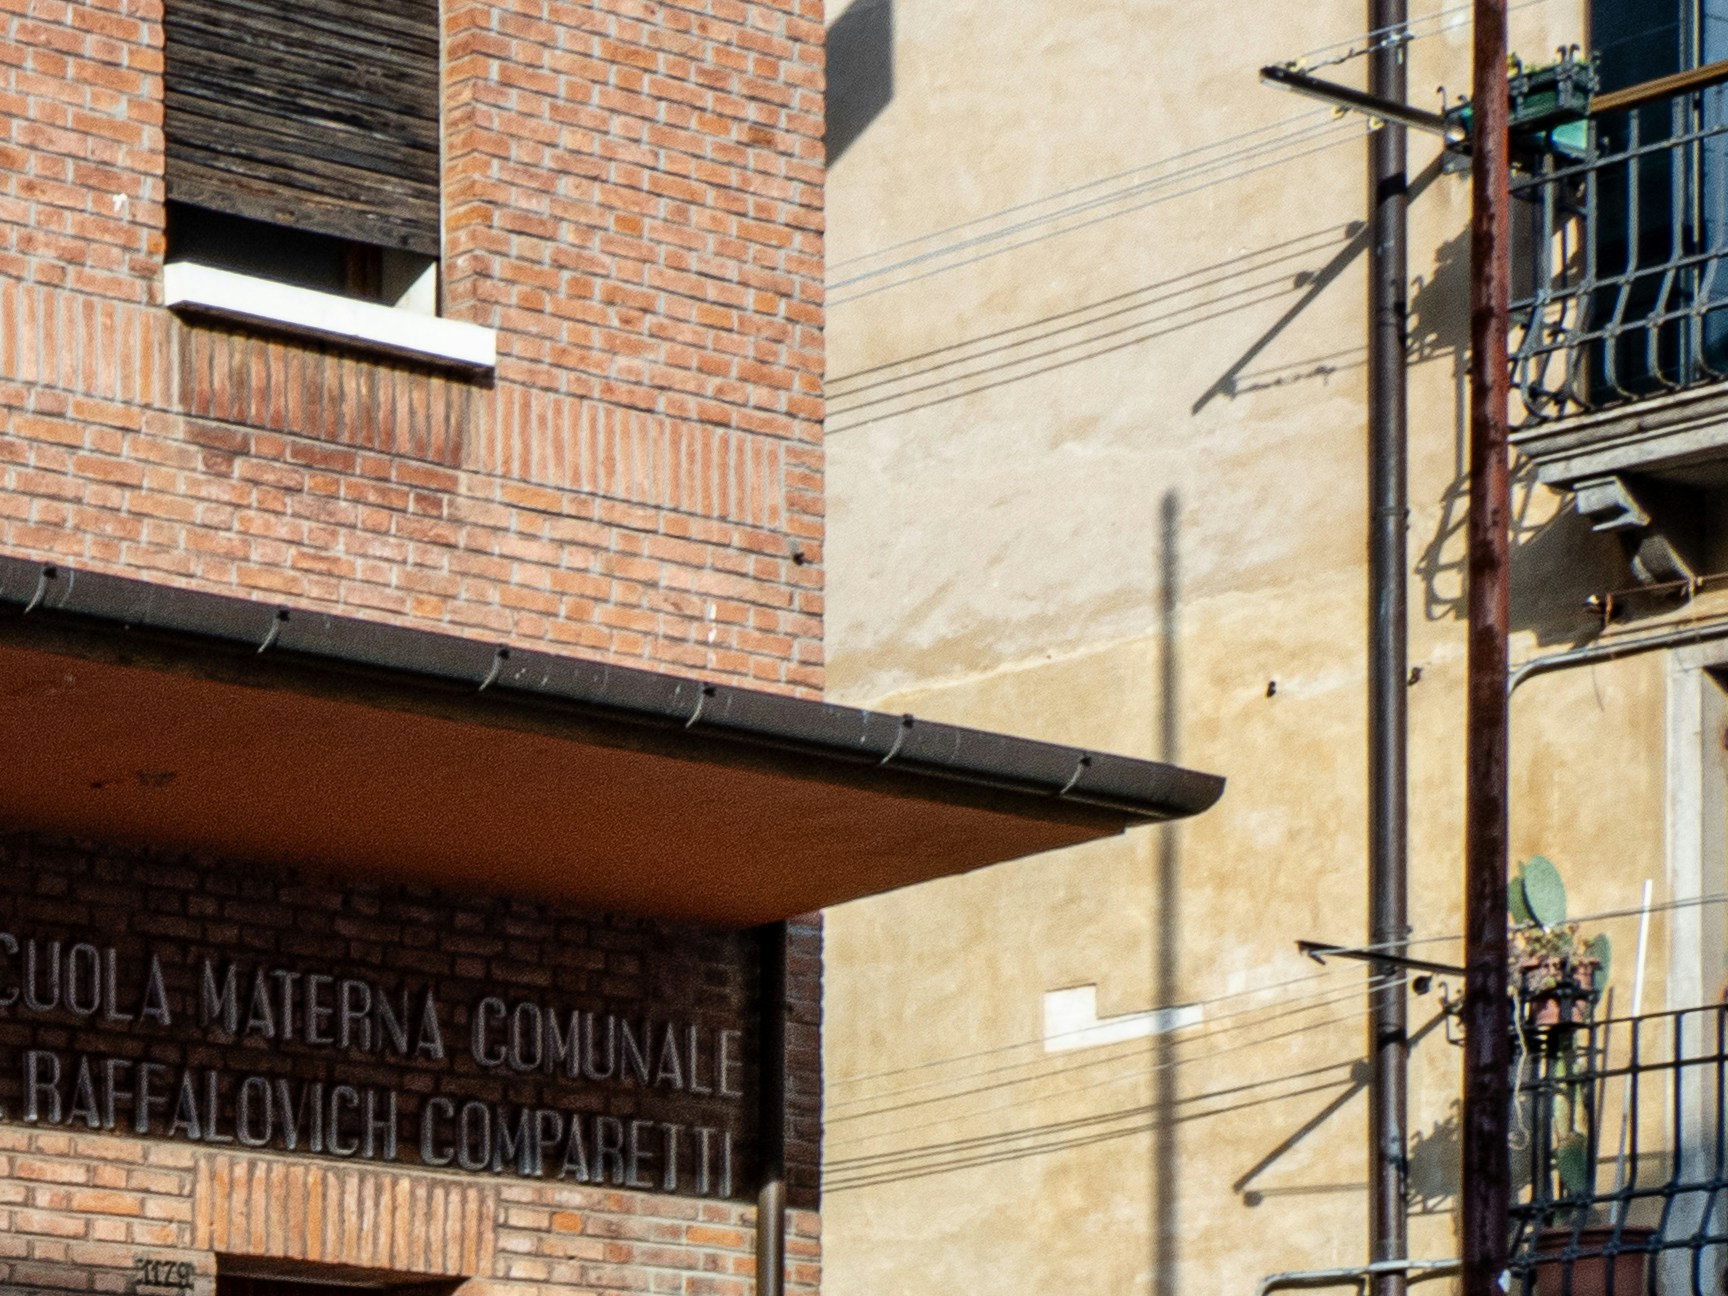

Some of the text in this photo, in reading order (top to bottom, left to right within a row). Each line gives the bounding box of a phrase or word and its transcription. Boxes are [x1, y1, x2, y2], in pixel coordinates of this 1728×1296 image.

[201, 959, 443, 1059] MATERNA
[472, 996, 744, 1098] COMUNALE
[23, 1049, 396, 1161] RAFFALOVICH
[420, 1097, 733, 1198] COMPARETTI
[144, 1259, 194, 1290] 1179
